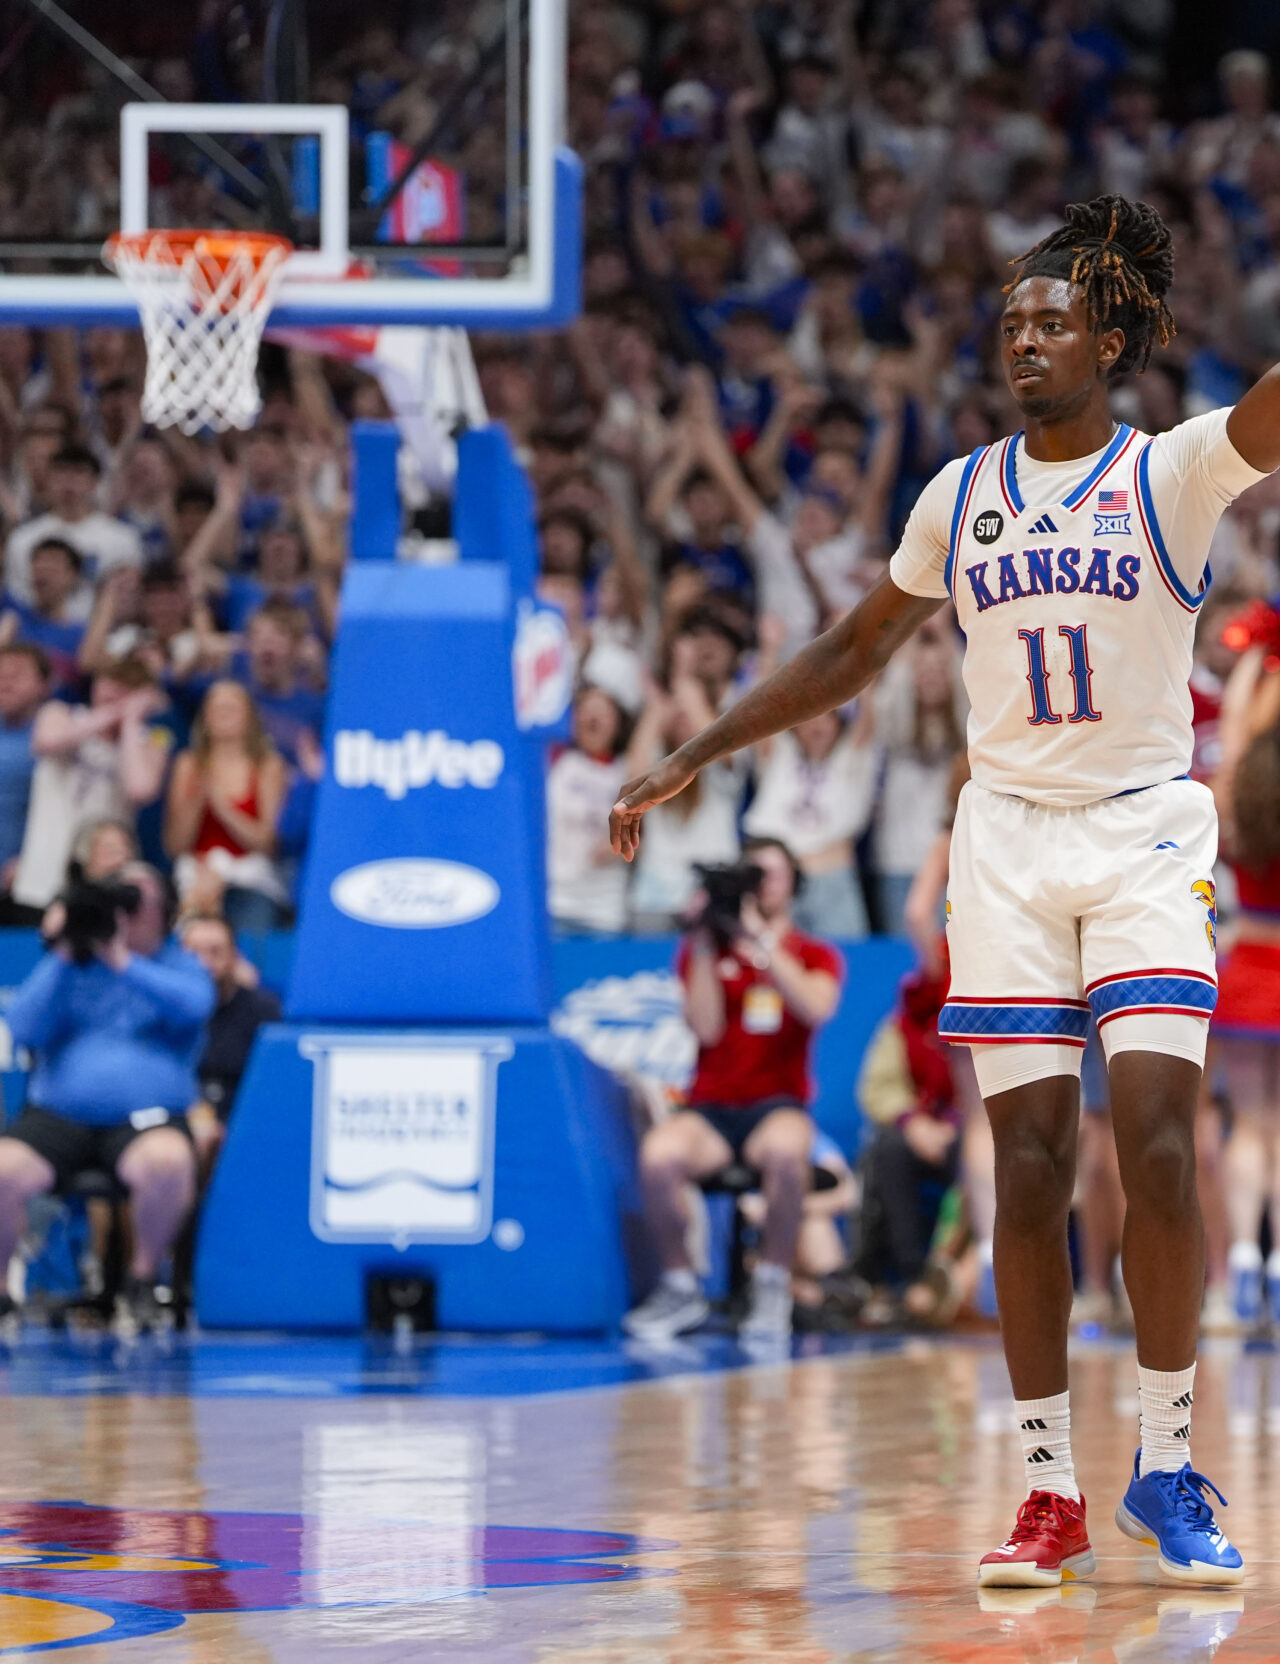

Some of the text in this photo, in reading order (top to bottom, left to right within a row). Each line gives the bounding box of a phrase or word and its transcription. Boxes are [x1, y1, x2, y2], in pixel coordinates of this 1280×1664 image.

[976, 517, 1000, 537] SW
[1096, 514, 1129, 534] XII
[965, 547, 1141, 612] KANSAS
[1018, 624, 1102, 725] 11
[334, 729, 505, 800] HyVee
